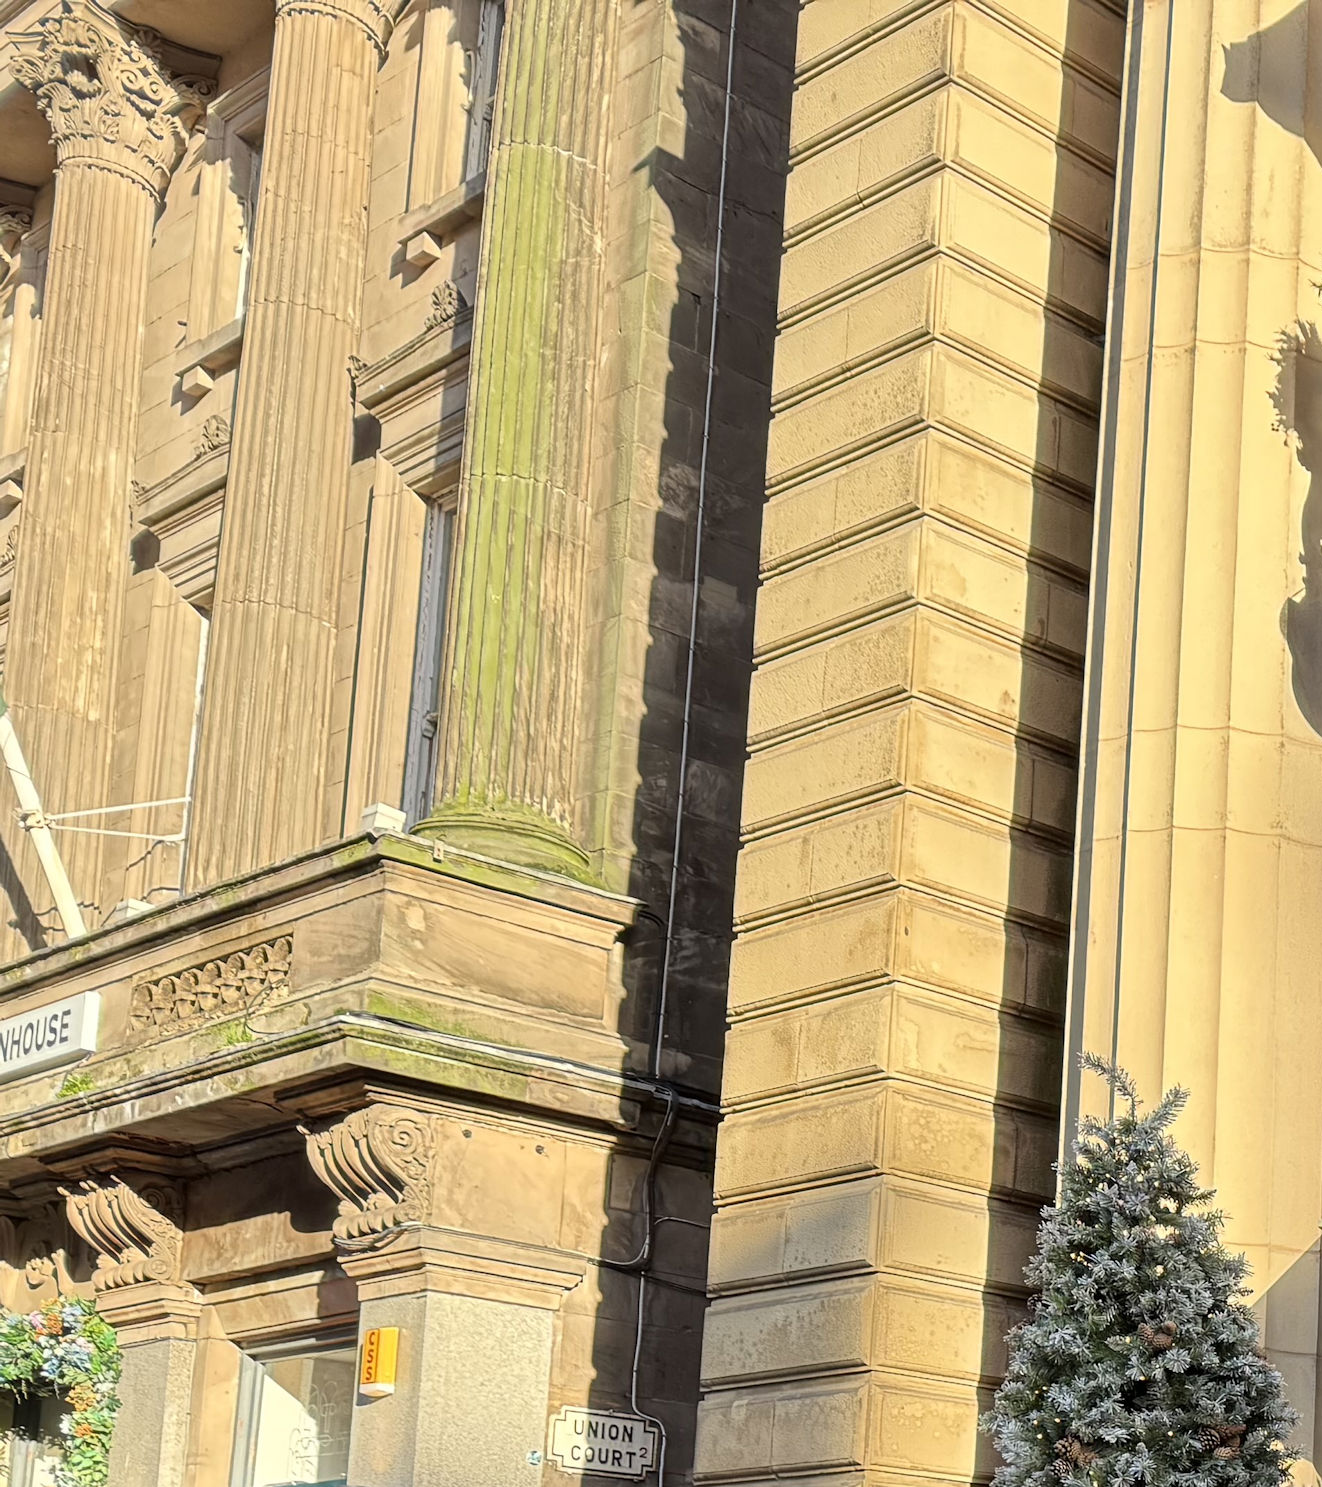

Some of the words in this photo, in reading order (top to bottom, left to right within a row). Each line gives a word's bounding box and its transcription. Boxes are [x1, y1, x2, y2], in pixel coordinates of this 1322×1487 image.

[365, 1331, 376, 1381] CSS
[574, 1419, 634, 1443] UNION
[571, 1445, 636, 1469] COURT
[639, 1447, 648, 1459] 2
